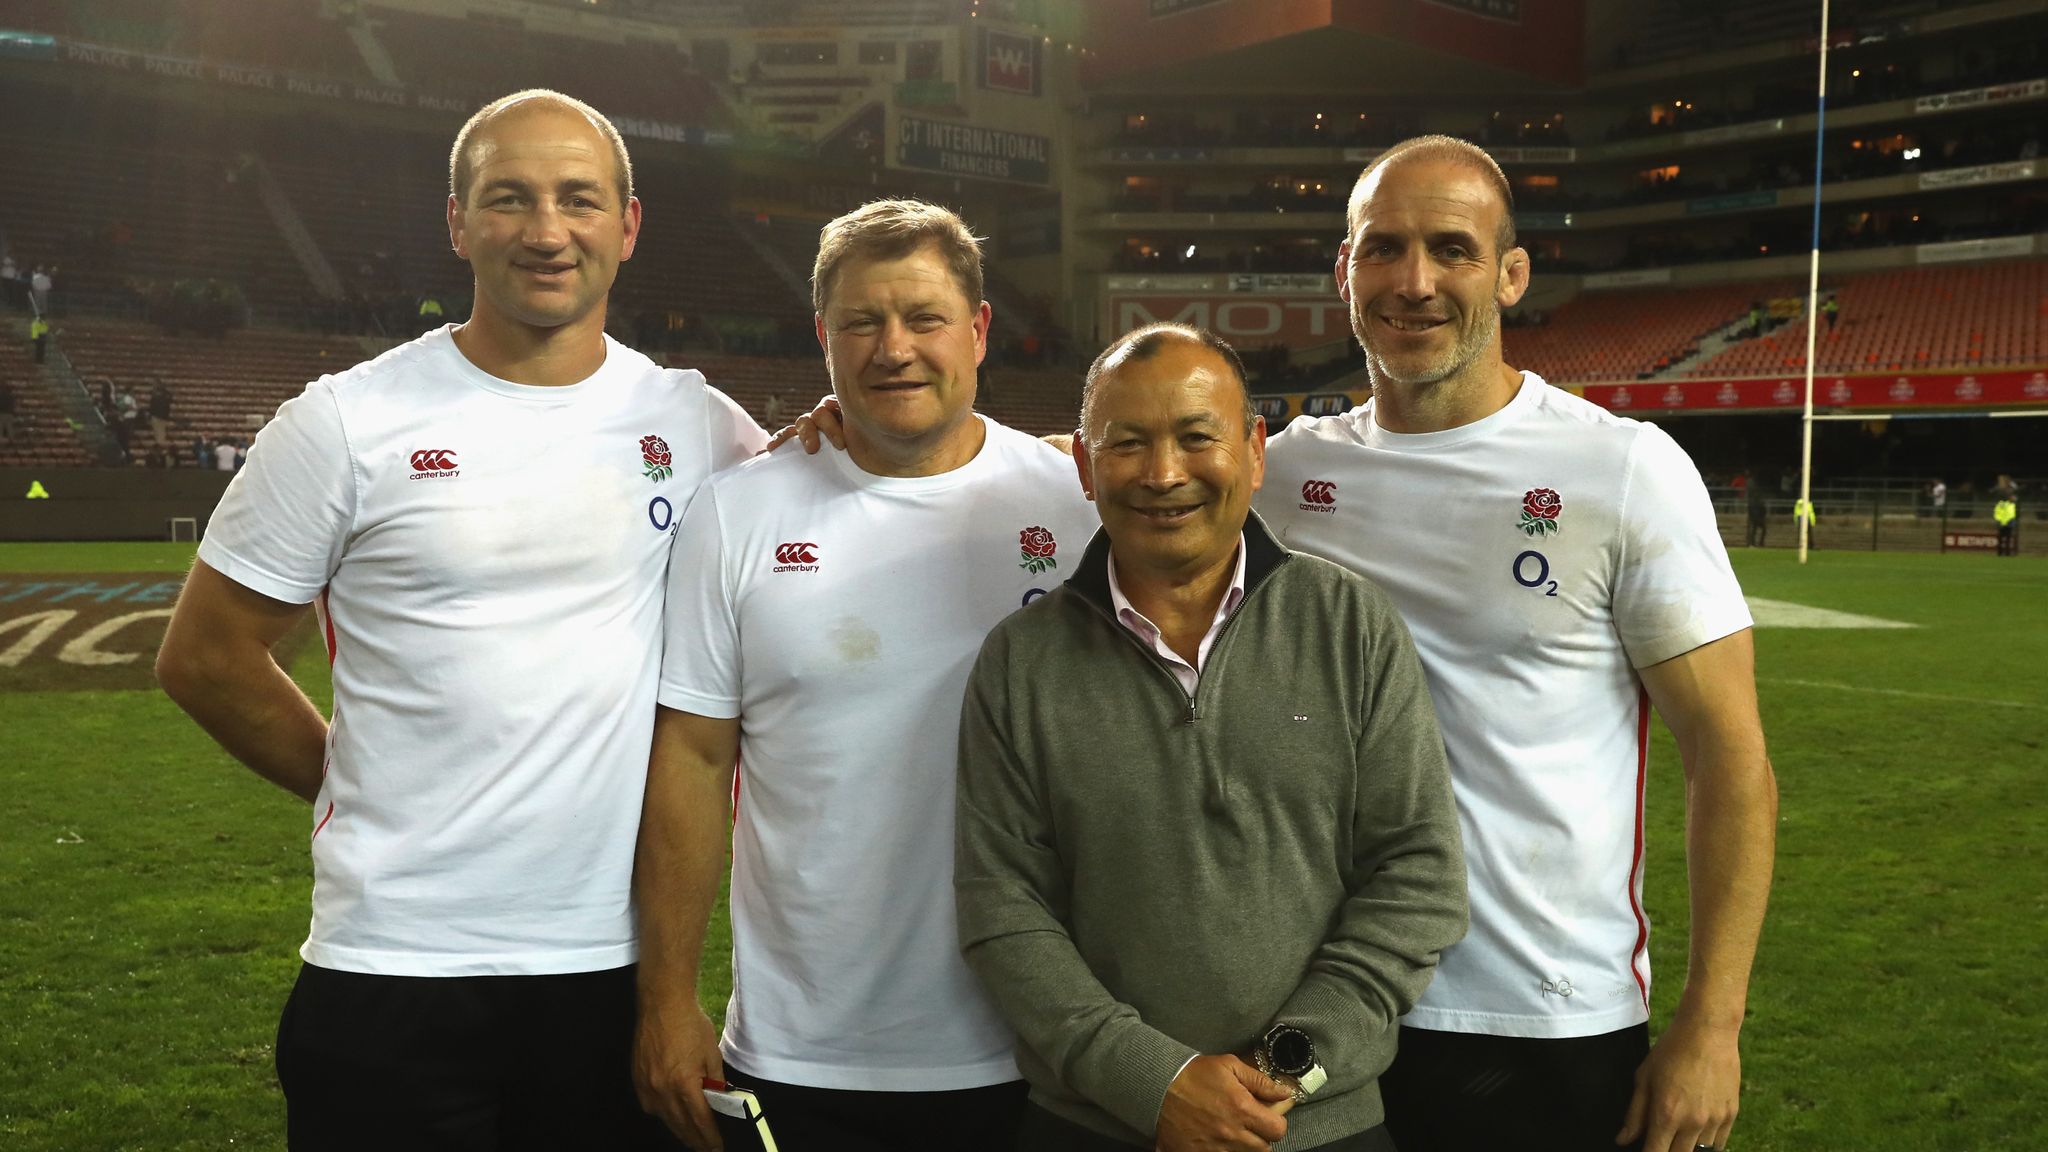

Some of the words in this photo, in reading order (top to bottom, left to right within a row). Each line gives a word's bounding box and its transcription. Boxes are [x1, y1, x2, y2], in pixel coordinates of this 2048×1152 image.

[287, 78, 342, 98] PALACE
[354, 86, 406, 106] PALACE
[900, 118, 921, 145] CT
[926, 123, 1046, 163] INTERNATIONAL
[940, 151, 1010, 177] FINANCIERS
[1310, 397, 1345, 414] MTN
[409, 469, 461, 481] canterbury
[1300, 503, 1337, 515] canterbury
[773, 564, 820, 574] canterbury
